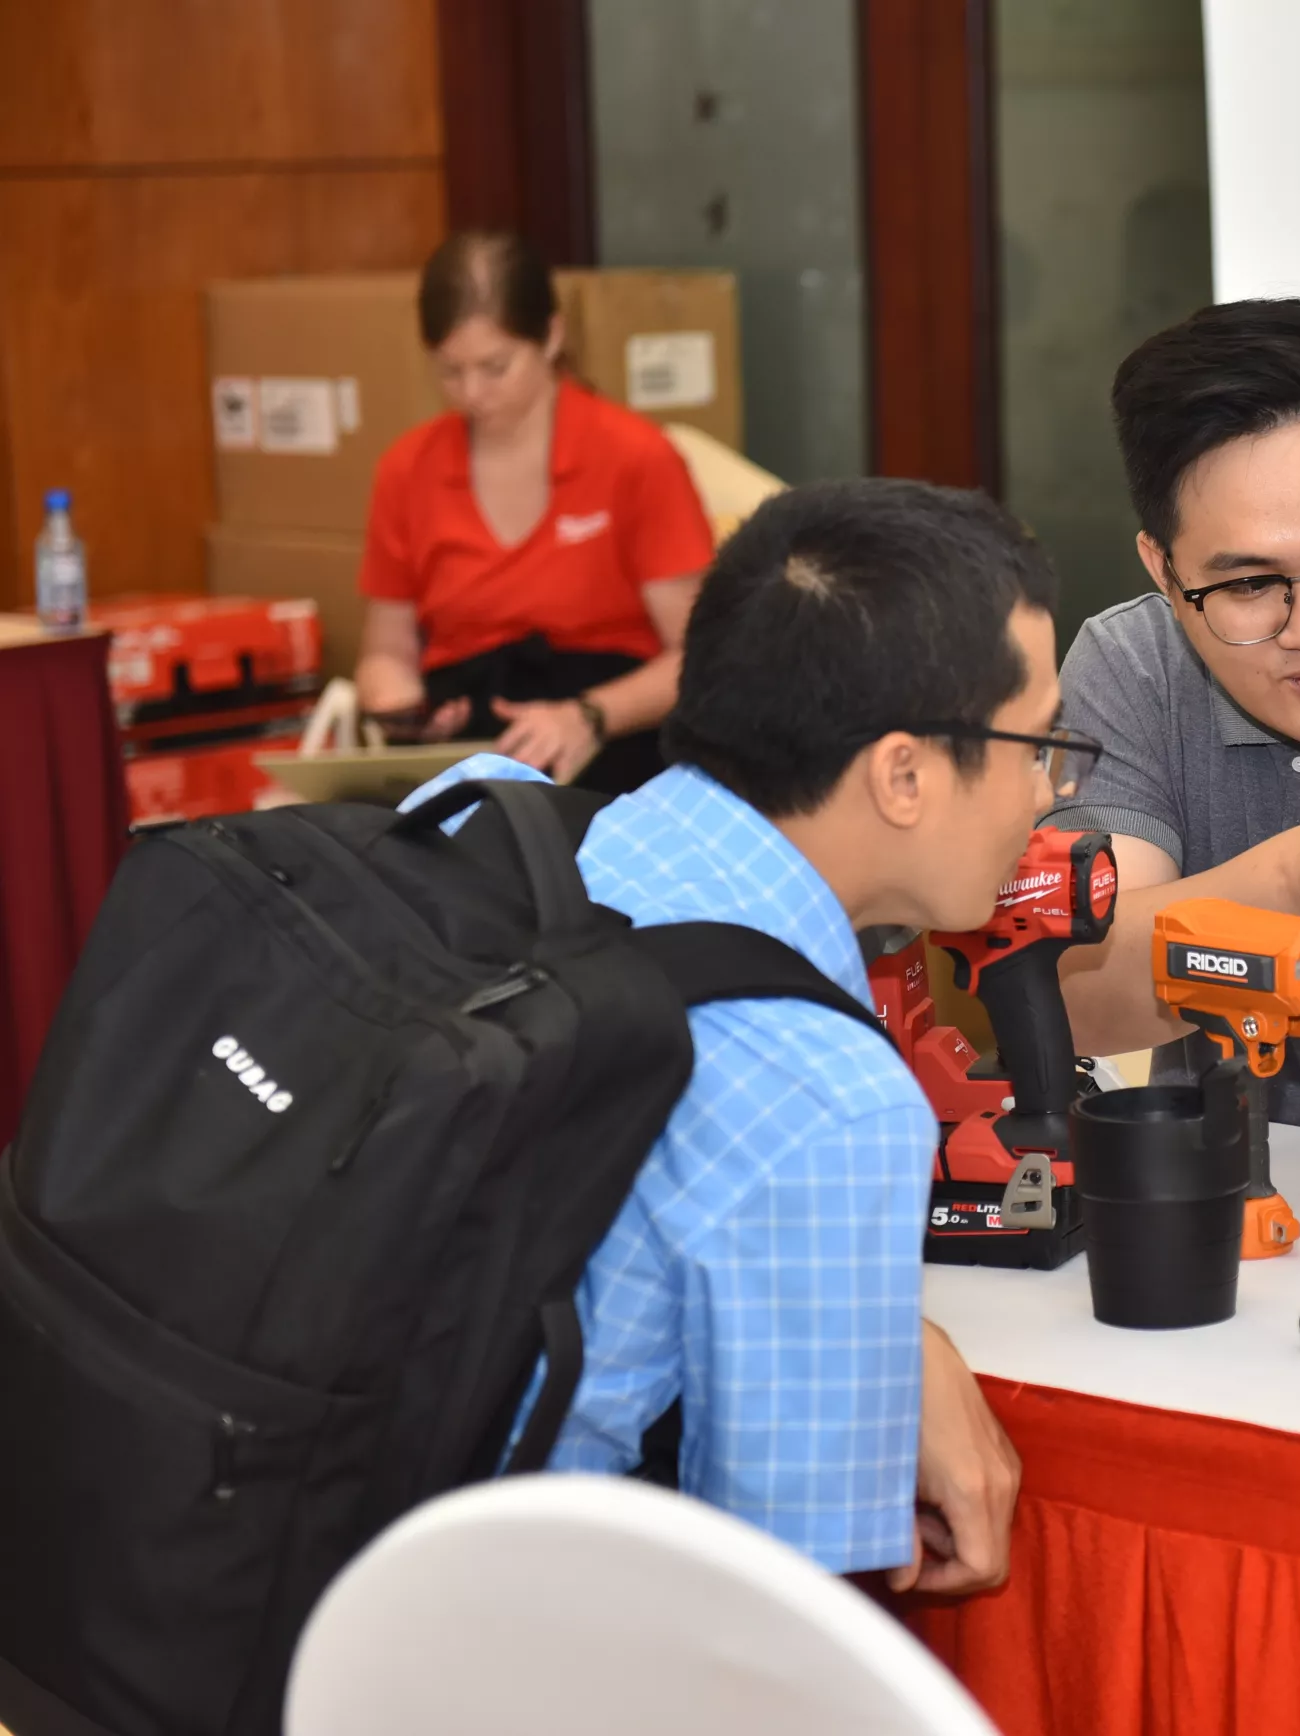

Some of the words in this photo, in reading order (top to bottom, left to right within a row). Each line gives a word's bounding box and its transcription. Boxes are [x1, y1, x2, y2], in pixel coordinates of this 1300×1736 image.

[1092, 873, 1116, 890] FUEL
[1032, 906, 1070, 917] FUEL
[1186, 951, 1249, 977] RIDGID
[952, 1202, 1003, 1214] REDLITH
